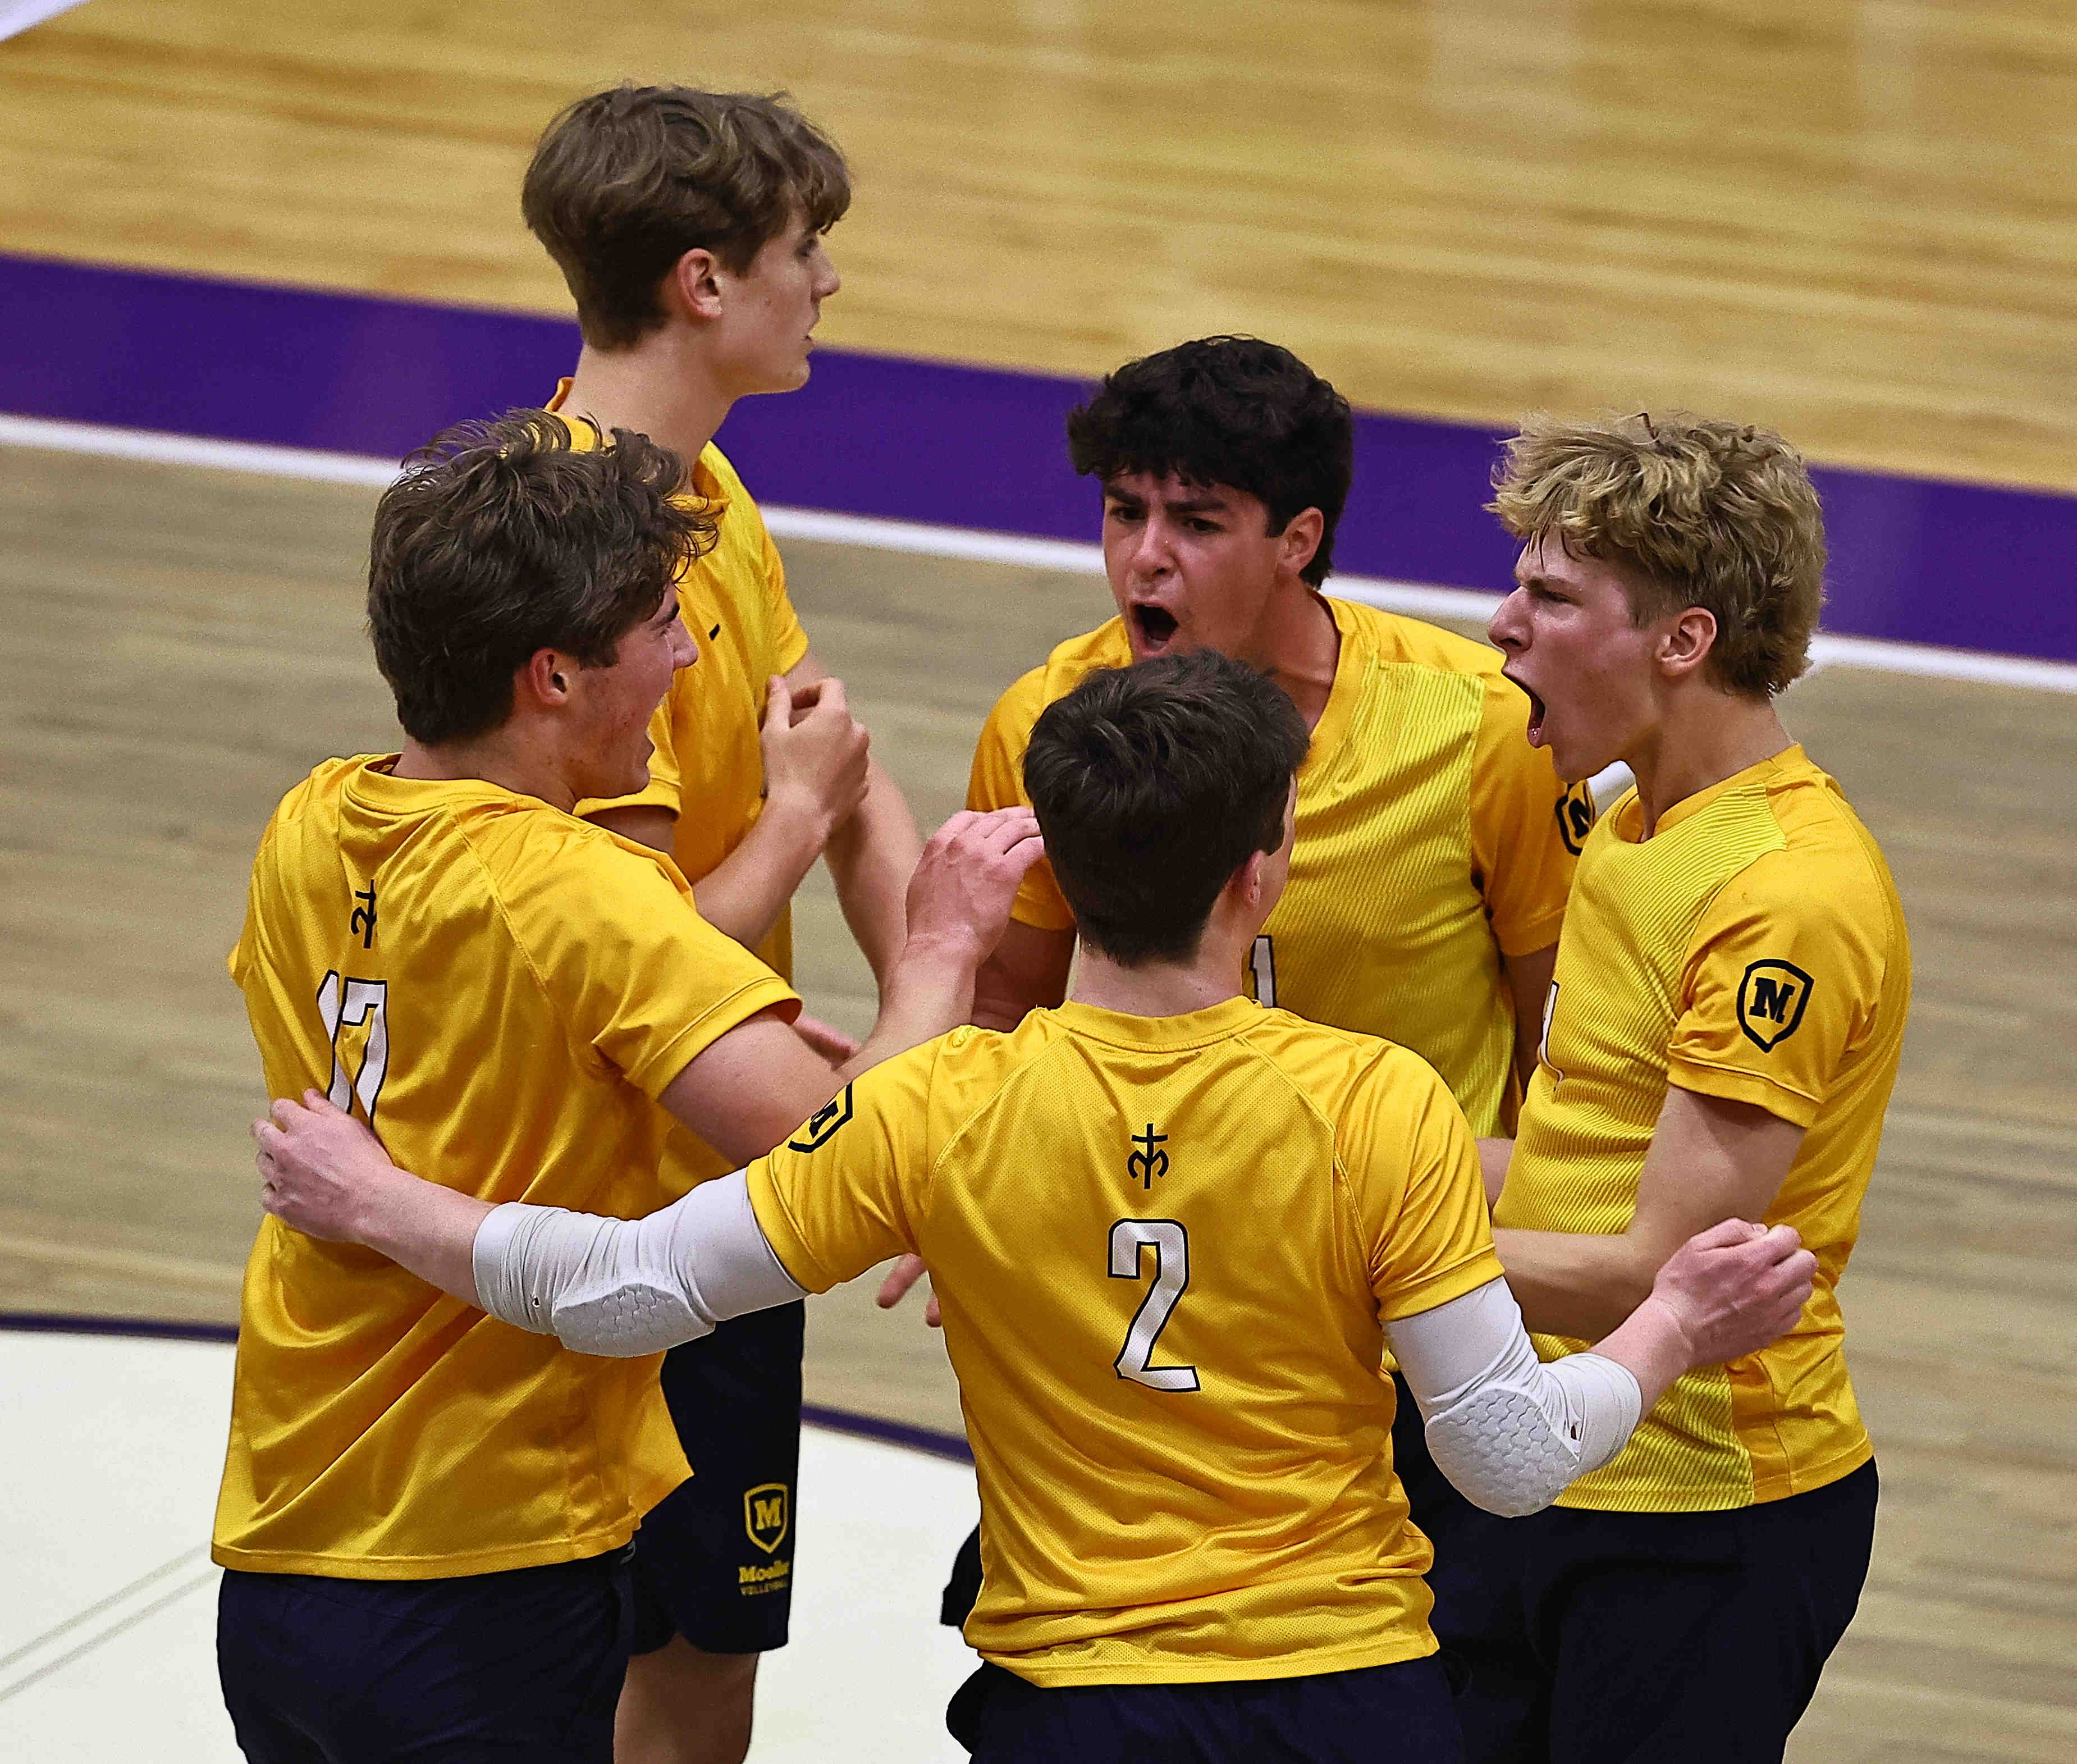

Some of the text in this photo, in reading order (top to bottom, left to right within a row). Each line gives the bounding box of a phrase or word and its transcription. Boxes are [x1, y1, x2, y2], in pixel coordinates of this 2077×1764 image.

[317, 970, 389, 1128] 17
[1749, 977, 1795, 1024] M
[1108, 1218, 1201, 1392] 2
[754, 1496, 782, 1530] M
